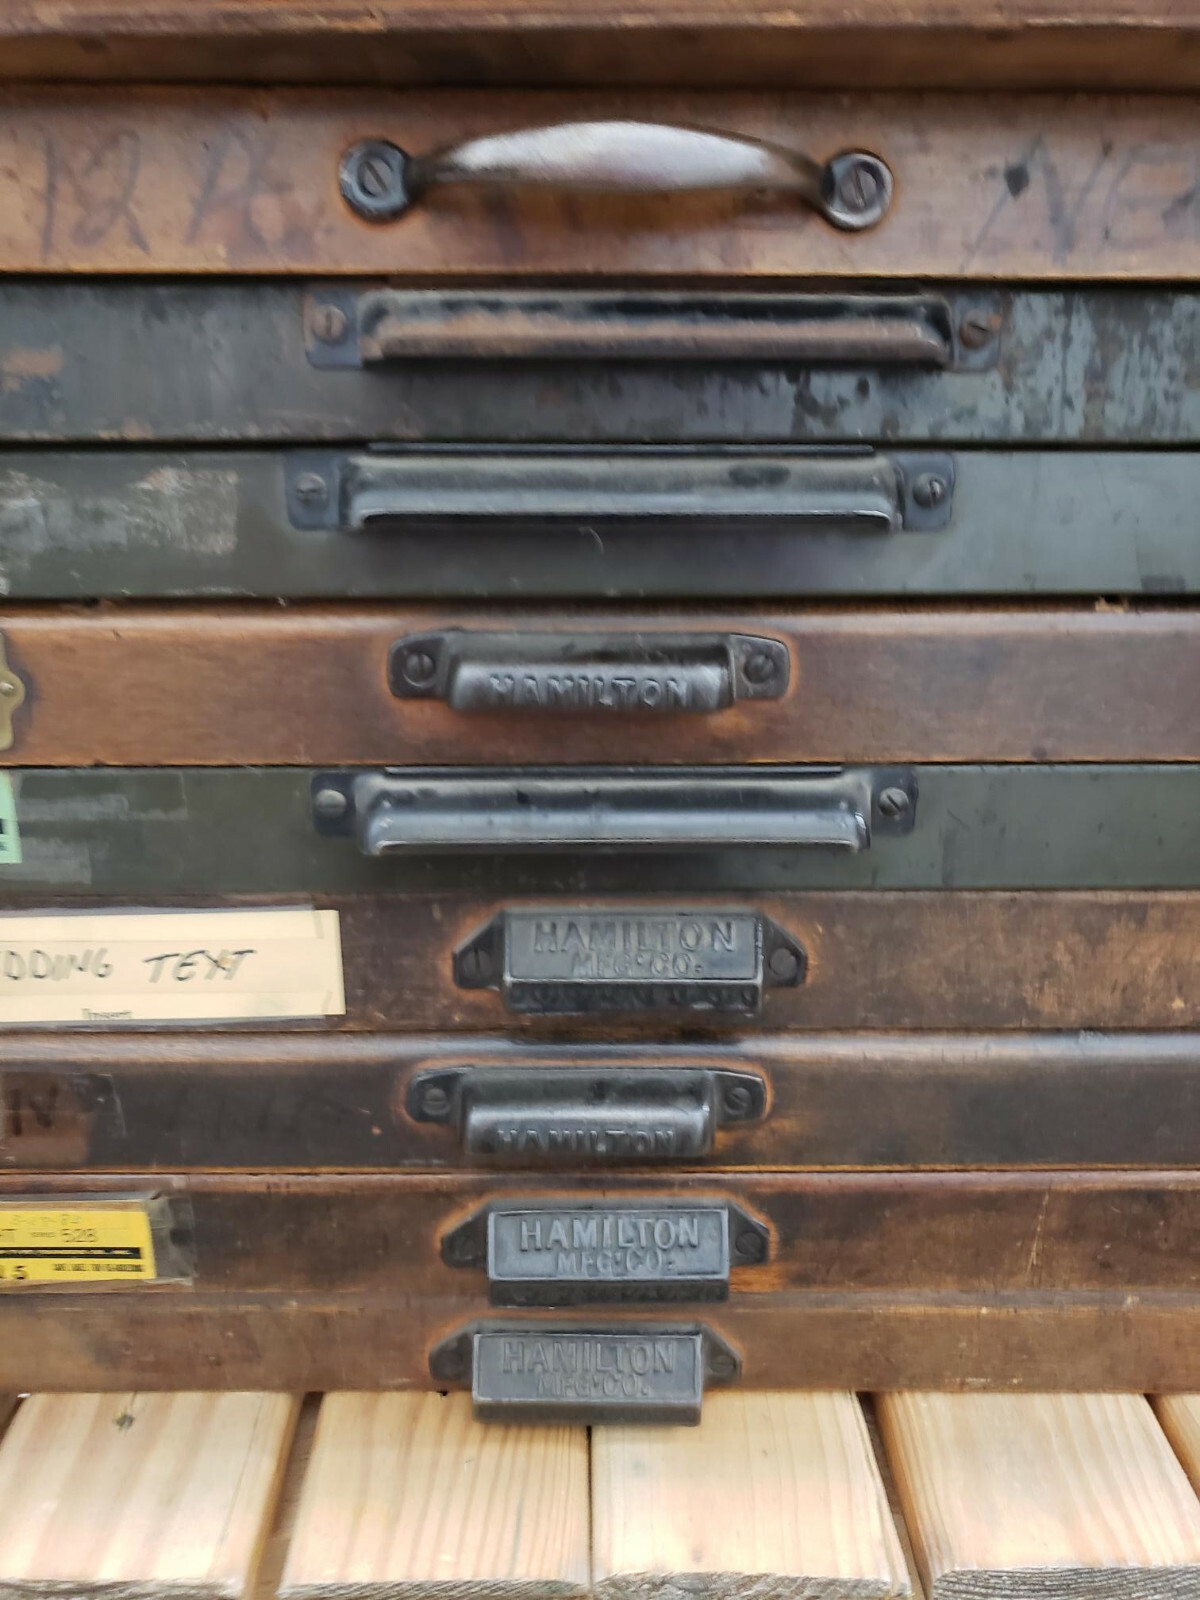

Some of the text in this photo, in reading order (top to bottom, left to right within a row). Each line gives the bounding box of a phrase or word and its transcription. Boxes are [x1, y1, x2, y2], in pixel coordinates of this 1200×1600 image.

[489, 672, 689, 706] HAMILTON
[533, 919, 737, 953] HAMILTON
[143, 949, 257, 983] TEXT
[496, 1128, 677, 1152] HAMILTON
[519, 1216, 699, 1251] HAMILTON
[502, 1339, 677, 1375] HAMILTON
